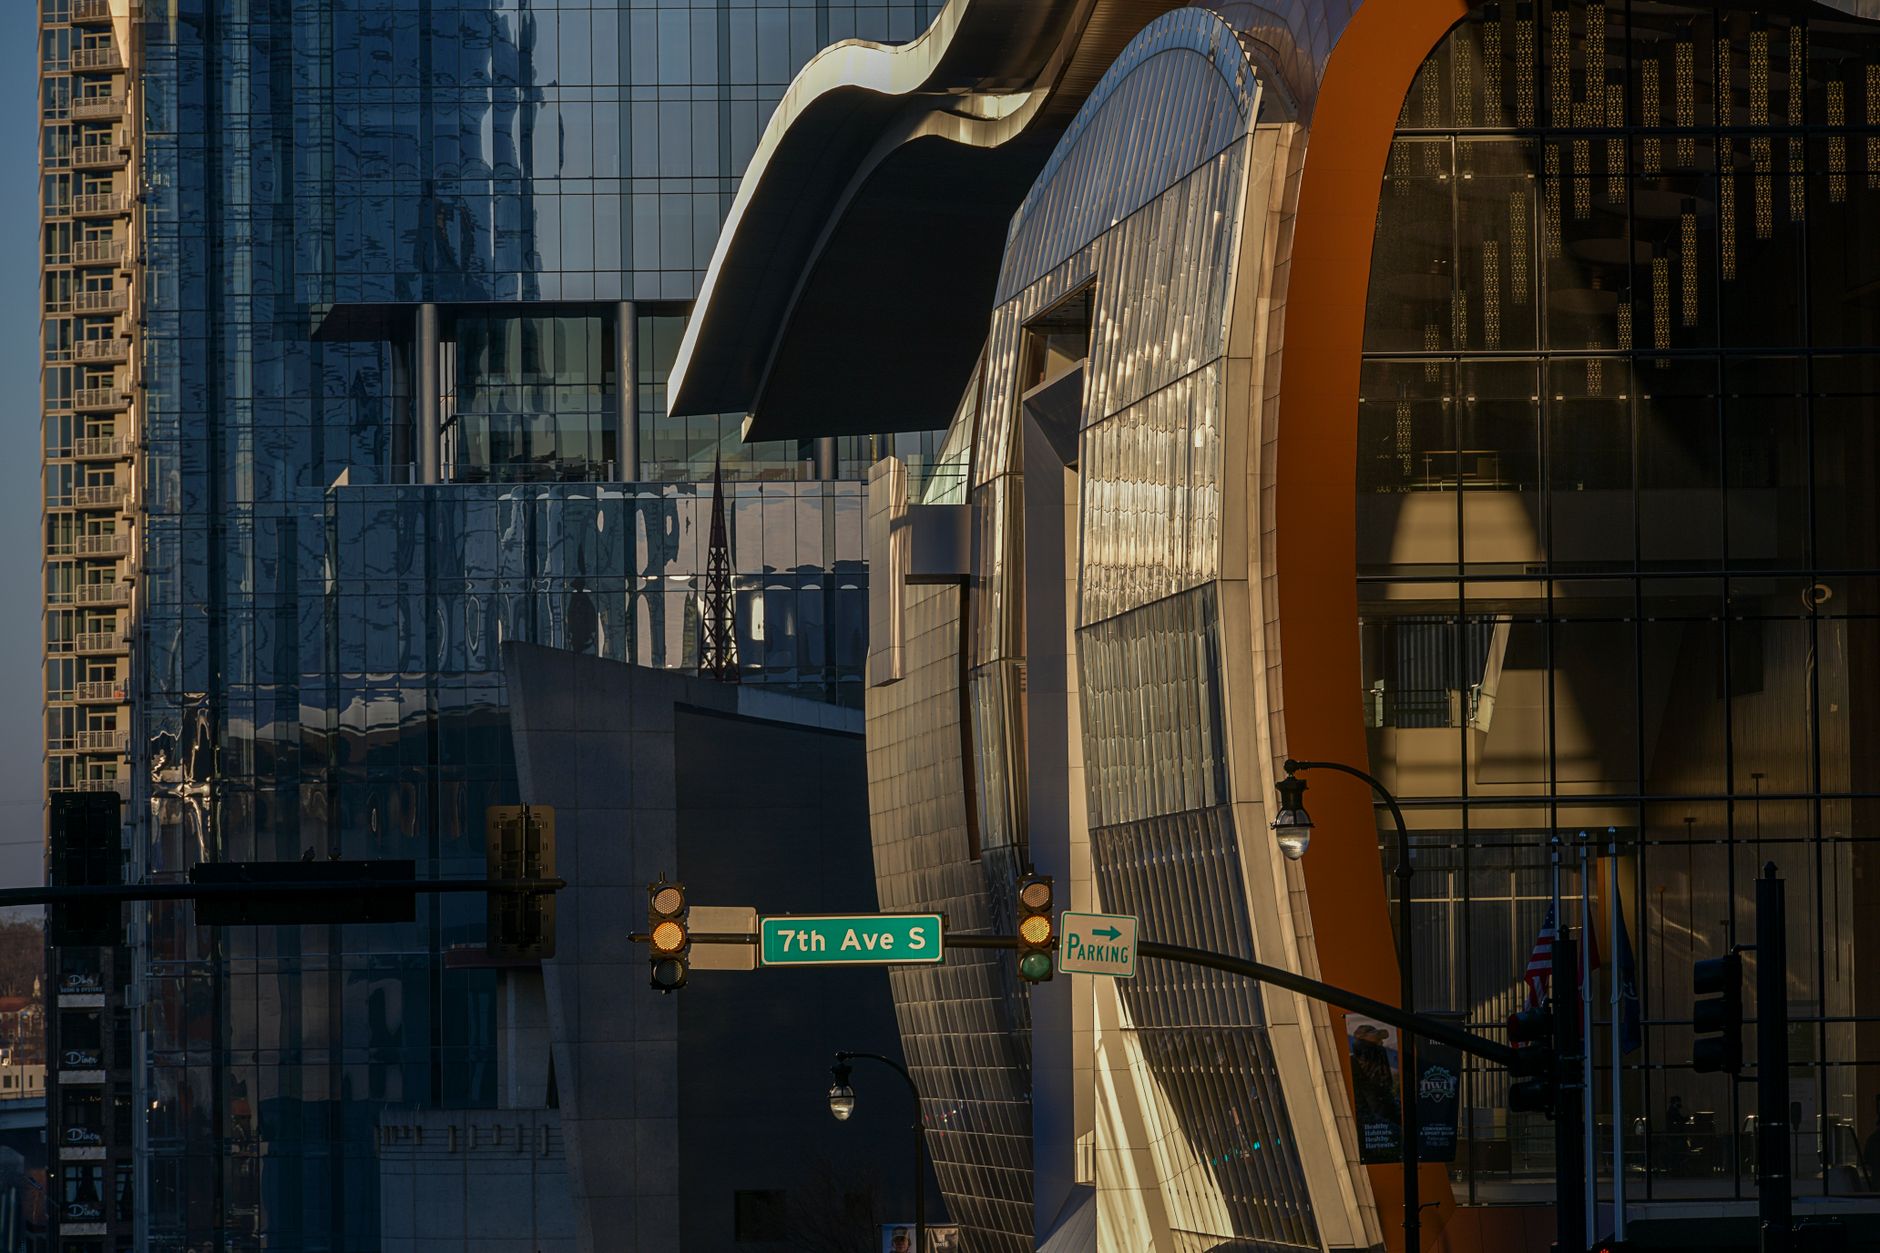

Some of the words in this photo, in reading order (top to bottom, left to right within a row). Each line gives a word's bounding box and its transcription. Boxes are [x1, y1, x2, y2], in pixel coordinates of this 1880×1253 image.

[777, 929, 826, 952] 7th
[840, 928, 895, 951] Ave
[908, 926, 926, 950] S
[1067, 932, 1129, 964] PARKING
